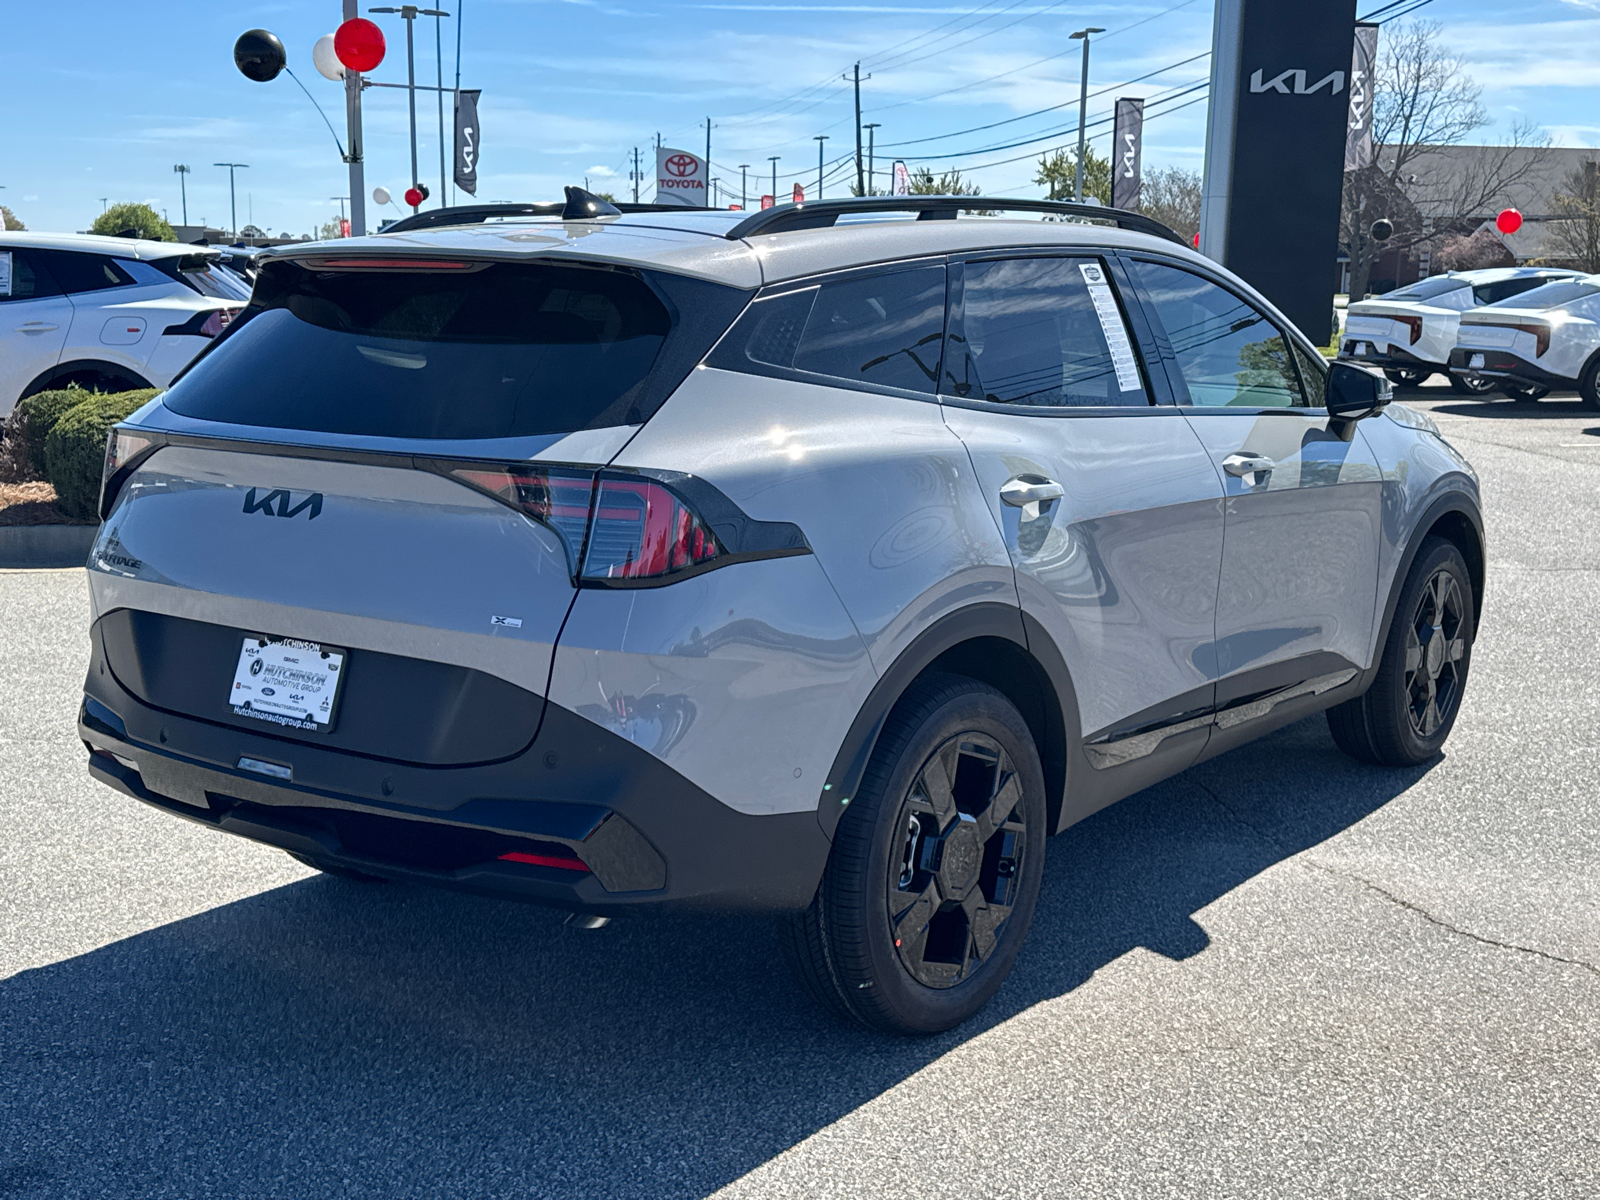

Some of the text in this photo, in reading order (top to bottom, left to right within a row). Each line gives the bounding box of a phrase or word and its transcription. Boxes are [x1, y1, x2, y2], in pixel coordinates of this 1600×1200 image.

[1250, 68, 1345, 95] KIA
[1350, 70, 1365, 129] KIA
[463, 127, 473, 174] KIA
[1123, 133, 1135, 178] KIA
[659, 179, 704, 189] TOYOTA
[243, 487, 323, 521] KIA
[97, 551, 142, 569] SRTAGE
[245, 647, 260, 655] KIA
[283, 656, 300, 664] GMC
[262, 676, 321, 693] AUTOMOTIVE GROUP
[289, 693, 304, 701] KIA
[233, 705, 318, 731] Hutchinsonautogroup.com
